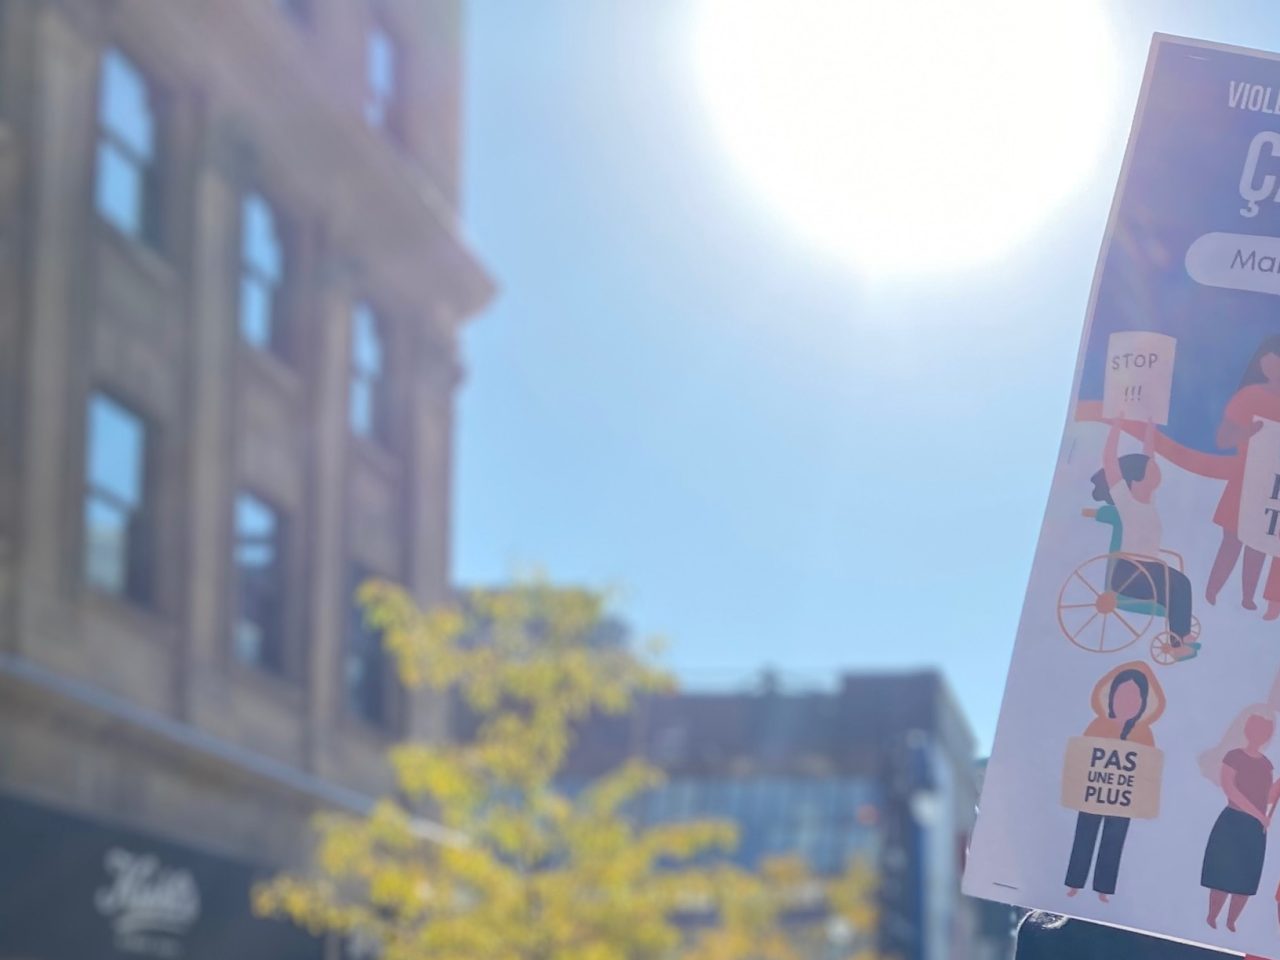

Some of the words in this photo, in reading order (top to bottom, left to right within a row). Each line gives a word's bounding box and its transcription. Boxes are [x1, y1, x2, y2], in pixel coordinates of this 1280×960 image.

[1111, 352, 1158, 370] STOP
[1124, 384, 1142, 402] !!!
[1090, 747, 1138, 772] PAS
[1087, 771, 1115, 785] UNE
[1117, 774, 1135, 787] DE
[1083, 785, 1132, 807] PLUS
